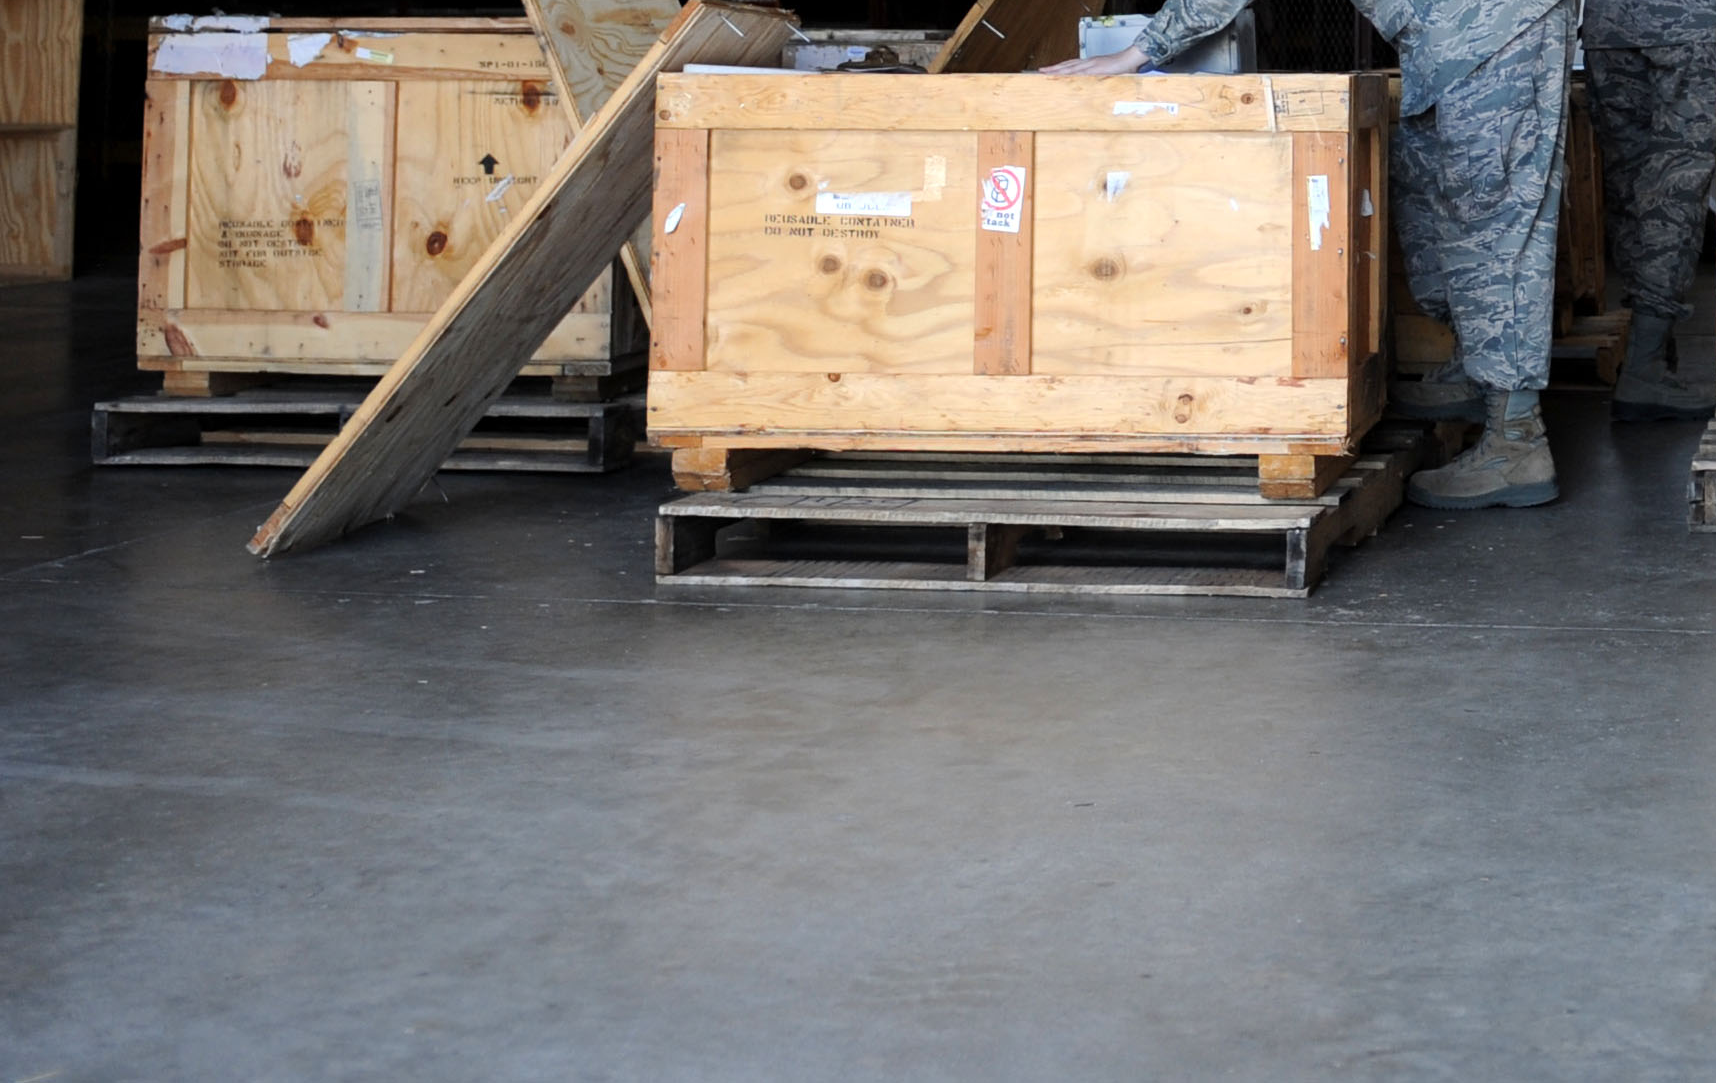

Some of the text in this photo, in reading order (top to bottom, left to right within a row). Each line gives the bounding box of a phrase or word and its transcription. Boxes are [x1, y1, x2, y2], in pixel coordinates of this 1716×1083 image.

[764, 213, 916, 228] REUSABLE CONTAINER
[996, 212, 1015, 220] not
[983, 218, 1010, 228] tack
[764, 227, 880, 239] DO NOT DESTROY
